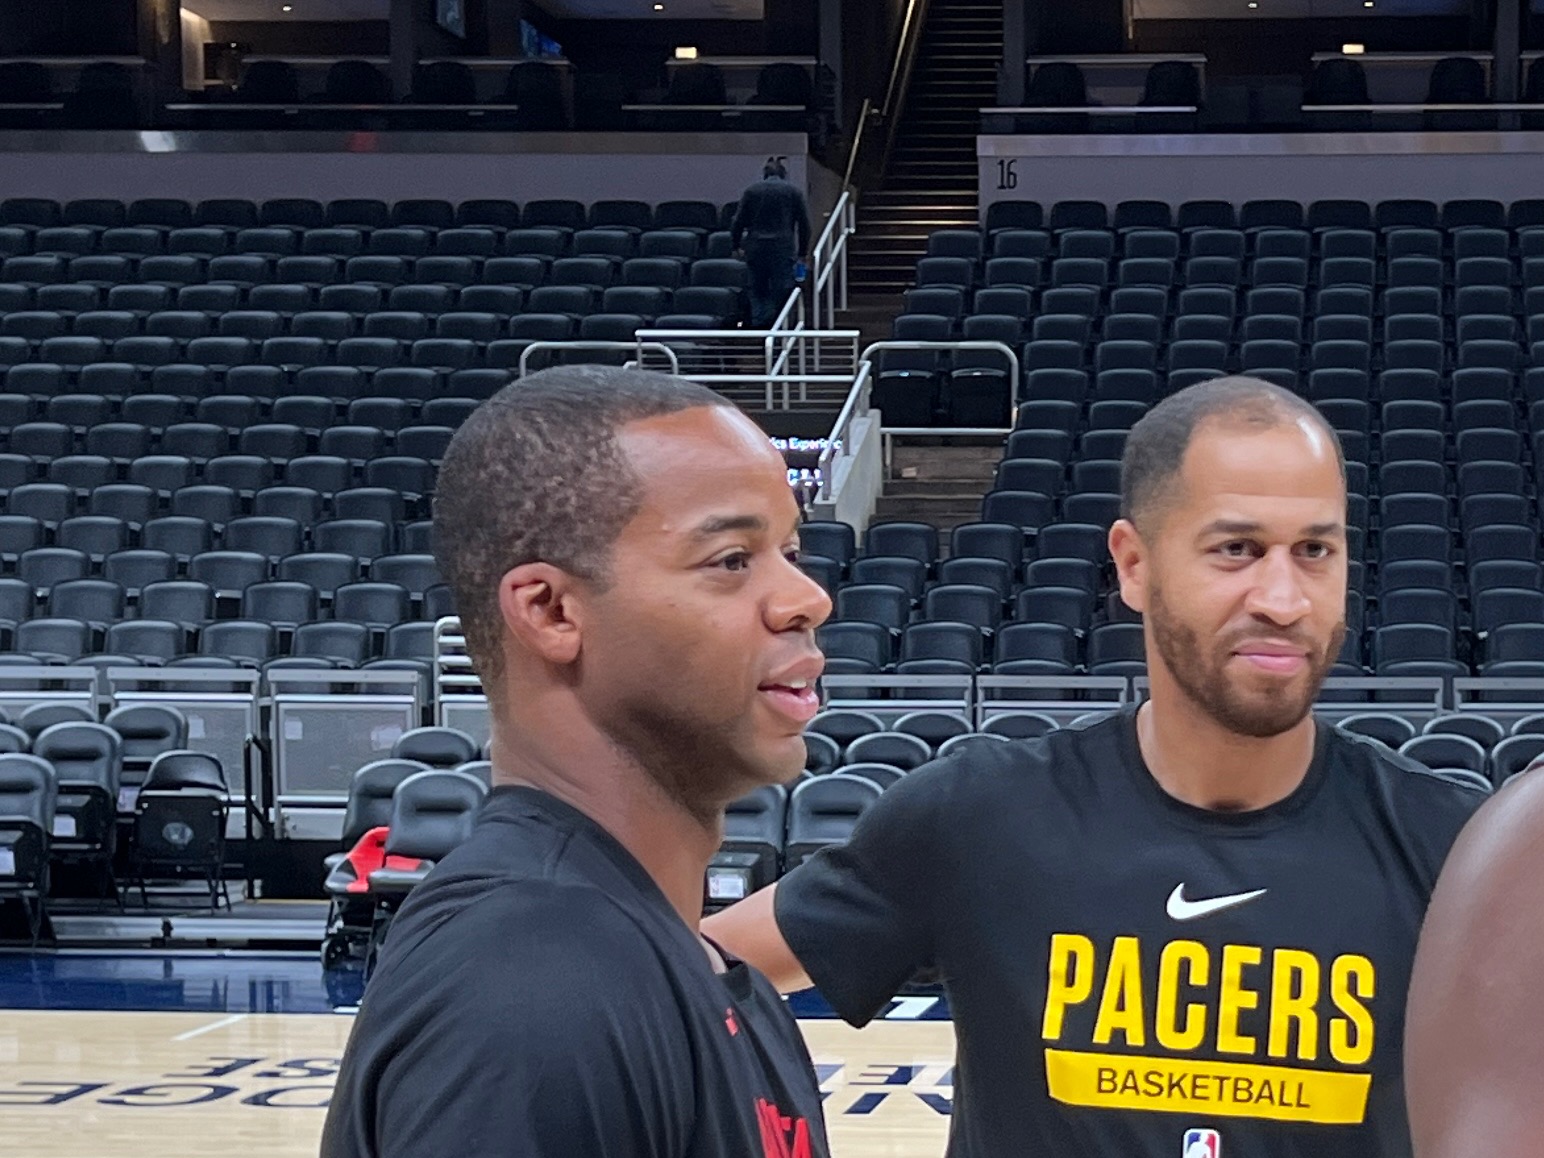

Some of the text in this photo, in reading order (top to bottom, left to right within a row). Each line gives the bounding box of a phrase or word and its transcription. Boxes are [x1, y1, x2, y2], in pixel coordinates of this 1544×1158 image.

[997, 159, 1018, 190] 16
[1042, 933, 1375, 1065] PACERS
[1096, 1066, 1311, 1109] BASKETBALL
